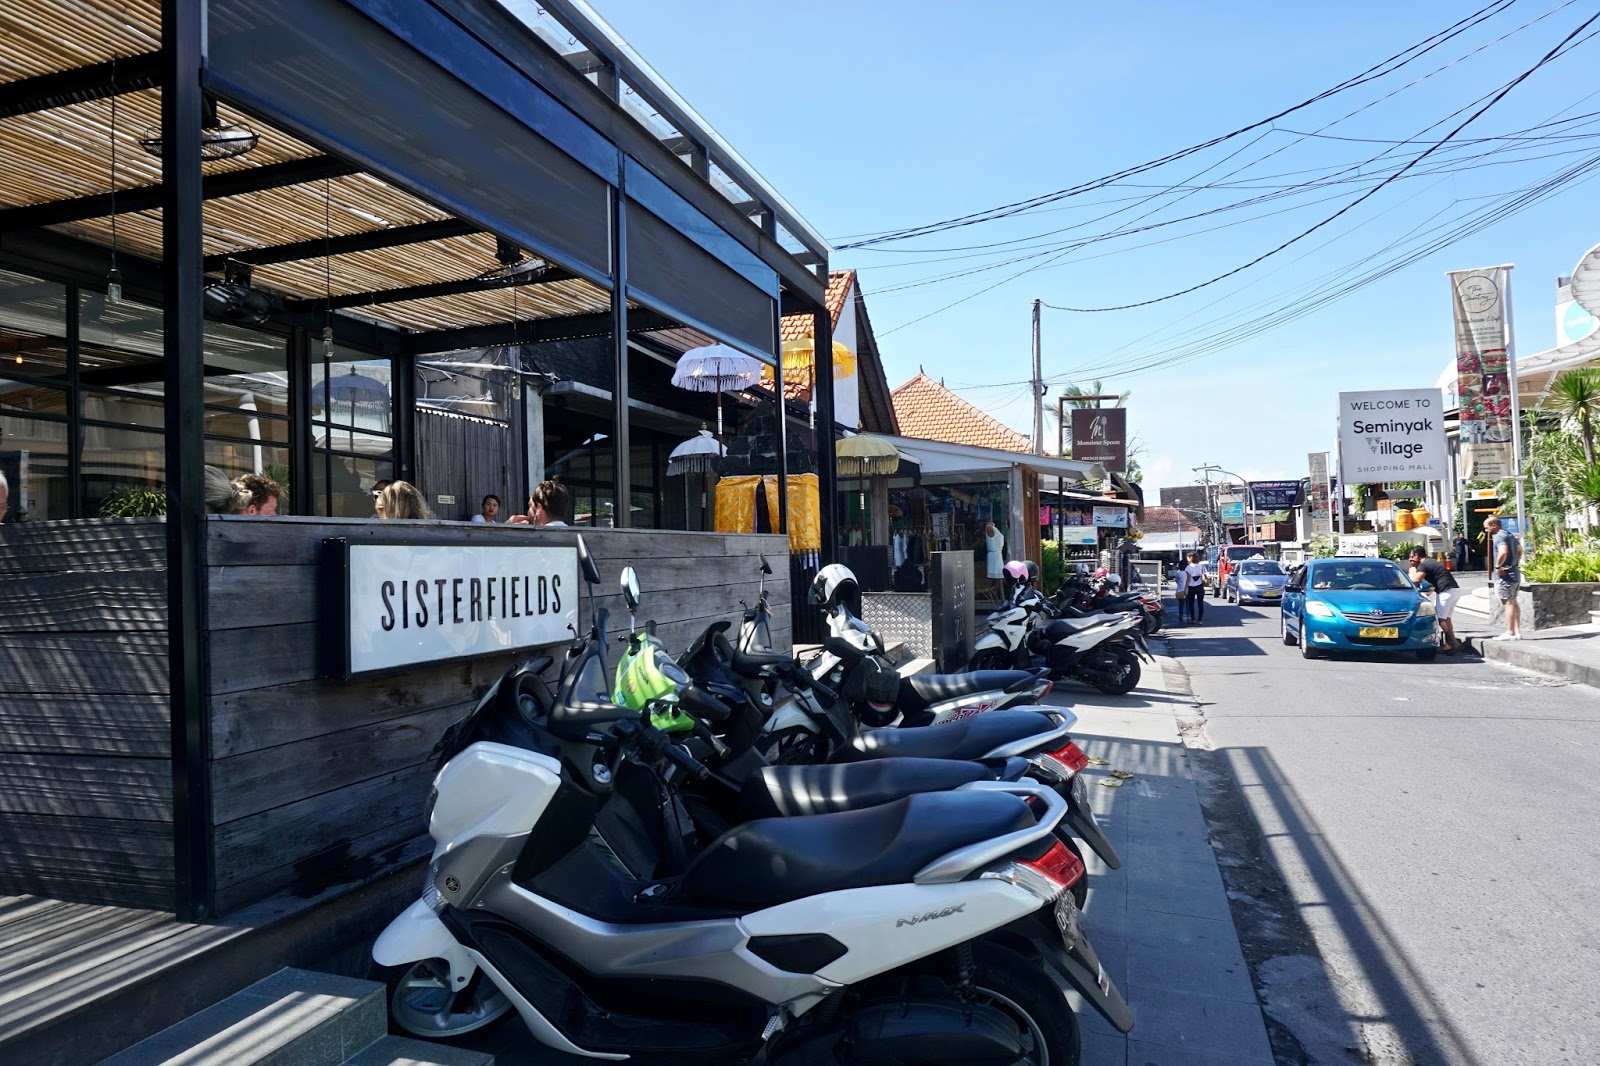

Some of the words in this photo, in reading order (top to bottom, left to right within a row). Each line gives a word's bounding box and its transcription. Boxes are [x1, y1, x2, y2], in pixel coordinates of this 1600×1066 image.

[1350, 400, 1410, 411] WELCOME
[1415, 399, 1431, 408] TO
[1353, 418, 1433, 435] Seminyak
[1357, 465, 1405, 473] SHOPPING
[381, 574, 561, 632] SISTERFIELDS
